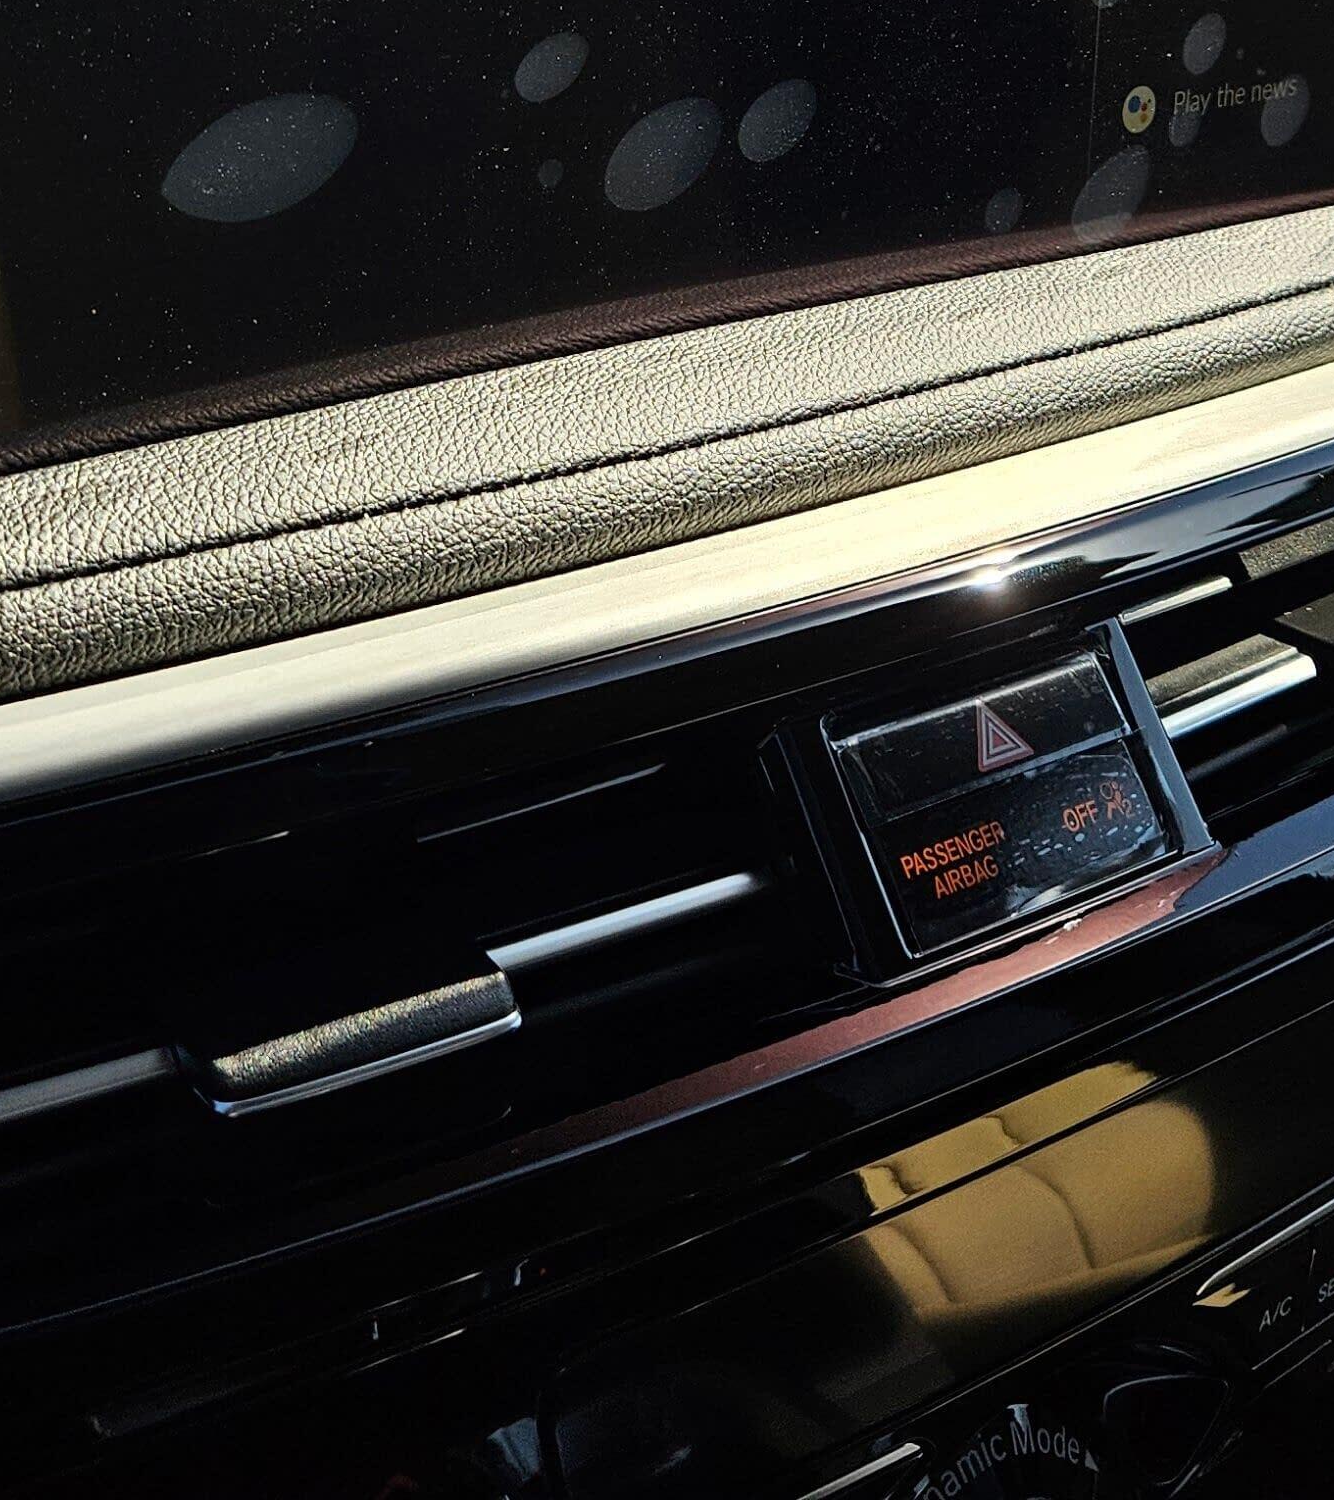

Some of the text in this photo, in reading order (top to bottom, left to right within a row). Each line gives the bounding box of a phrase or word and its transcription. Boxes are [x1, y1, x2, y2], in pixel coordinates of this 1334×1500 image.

[1172, 77, 1298, 117] Play the news
[1062, 799, 1099, 834] OFF
[899, 819, 1007, 880] PASSENGER
[932, 854, 1000, 900] AIRBAG
[1258, 1296, 1293, 1332] A/C
[1009, 1420, 1081, 1465] Mode
